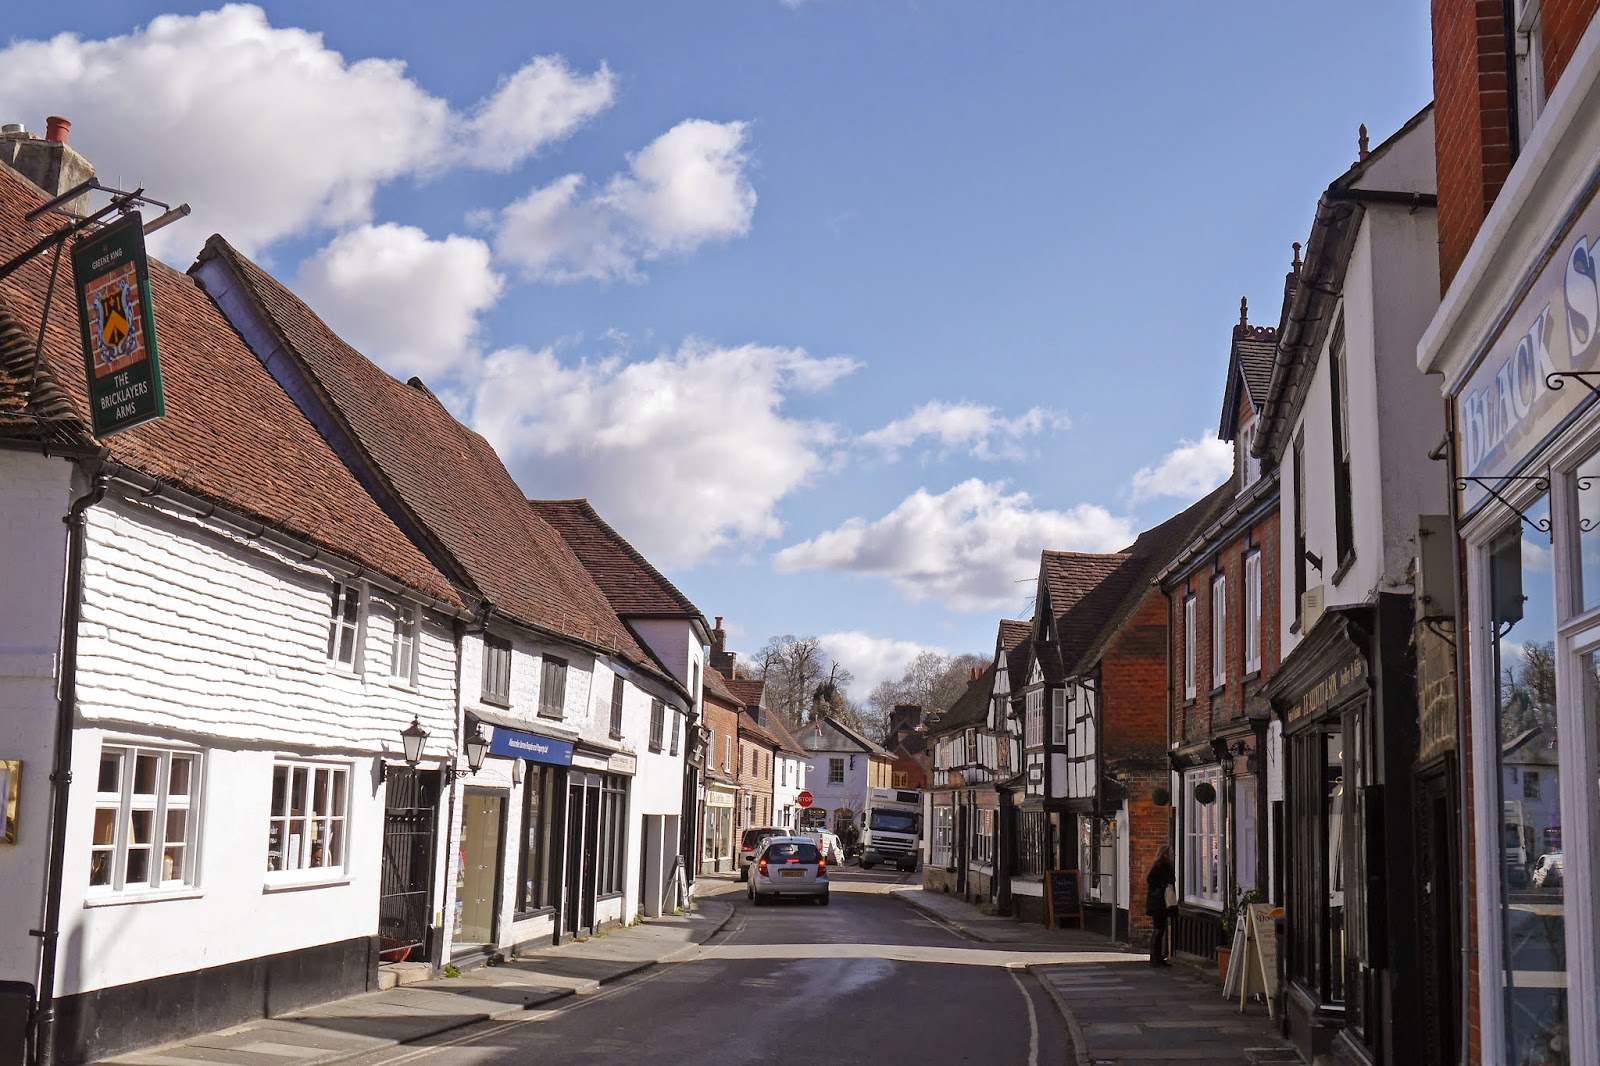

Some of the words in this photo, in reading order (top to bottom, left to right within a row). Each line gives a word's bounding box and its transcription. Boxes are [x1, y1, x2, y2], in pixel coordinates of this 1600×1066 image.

[91, 254, 110, 270] GREENE
[110, 247, 123, 261] KING
[113, 372, 129, 388] THE
[1464, 304, 1562, 477] BLACK
[100, 381, 148, 409] BRICKLAYERS
[116, 401, 136, 420] ARMS
